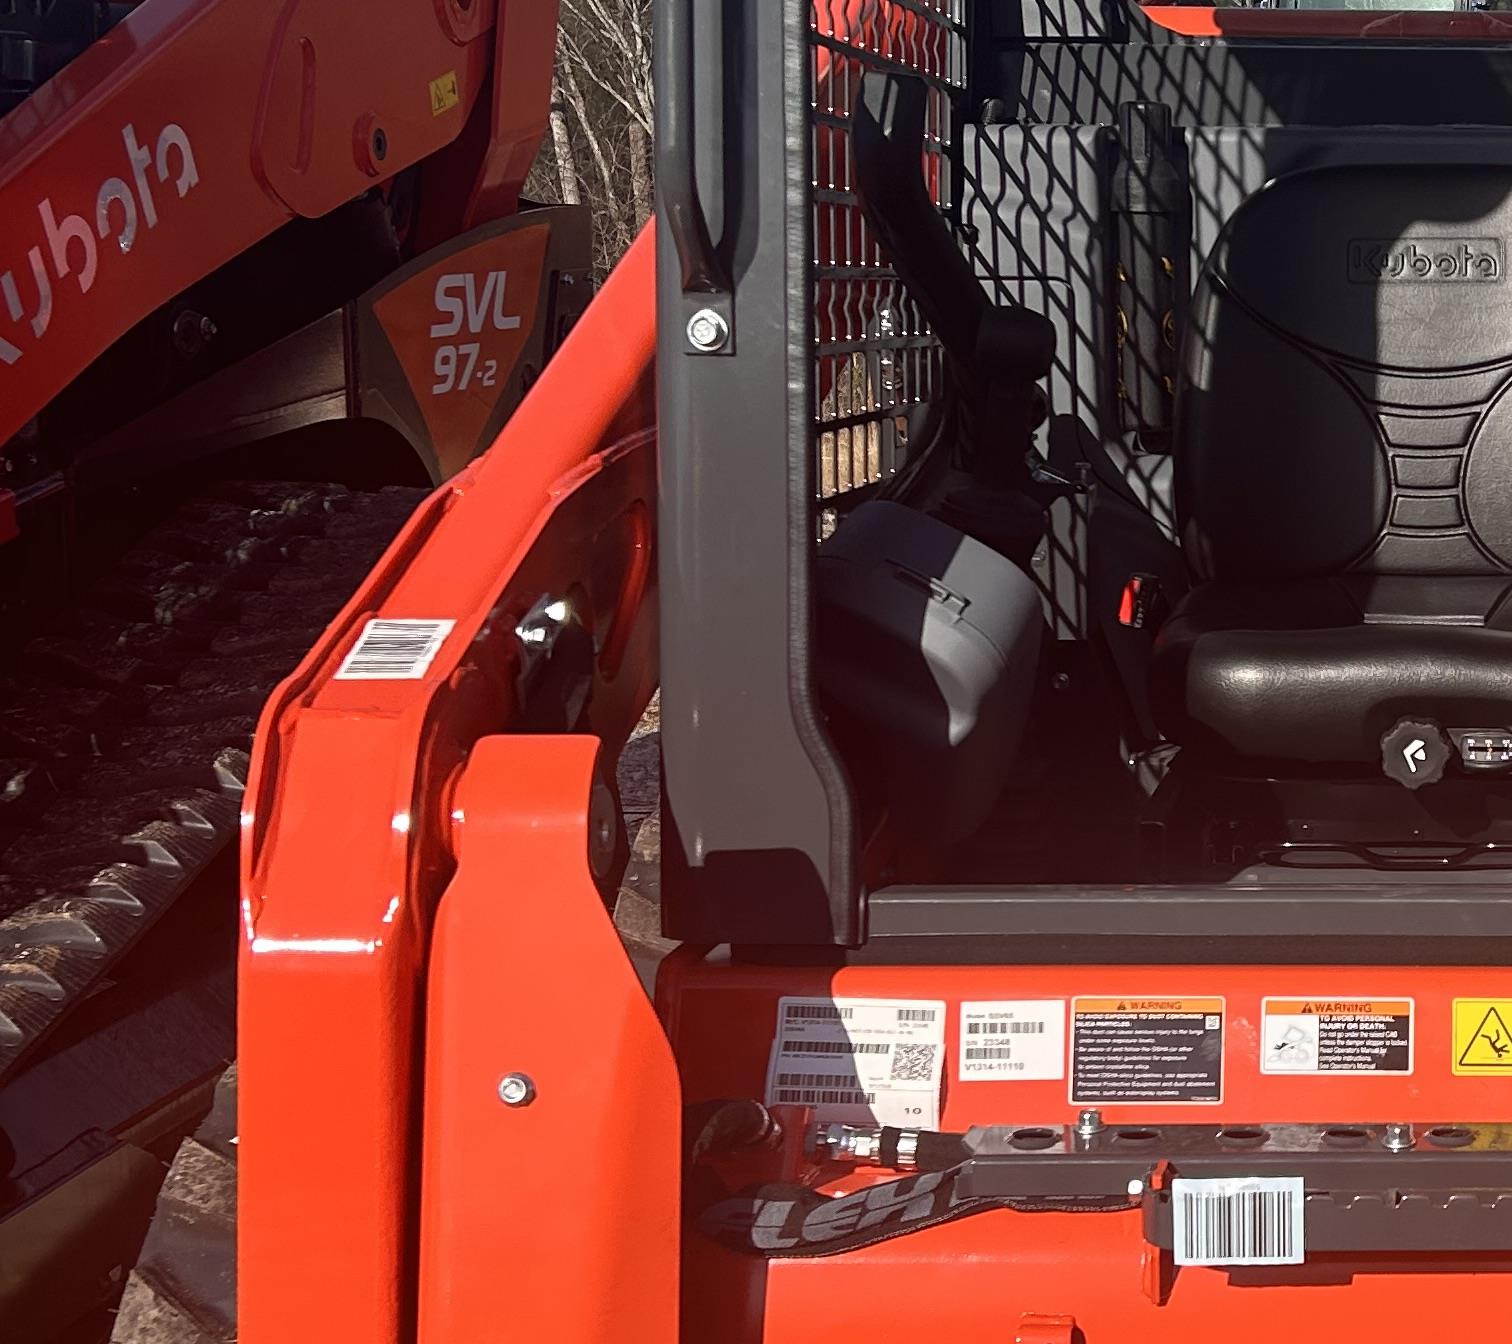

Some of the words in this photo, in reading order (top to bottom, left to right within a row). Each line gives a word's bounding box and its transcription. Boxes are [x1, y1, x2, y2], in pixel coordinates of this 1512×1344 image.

[1352, 244, 1499, 278] Kubota
[430, 271, 520, 338] SVL
[1130, 1001, 1182, 1010] WARNING
[1314, 1003, 1372, 1013] WARNING
[904, 1107, 922, 1115] 10
